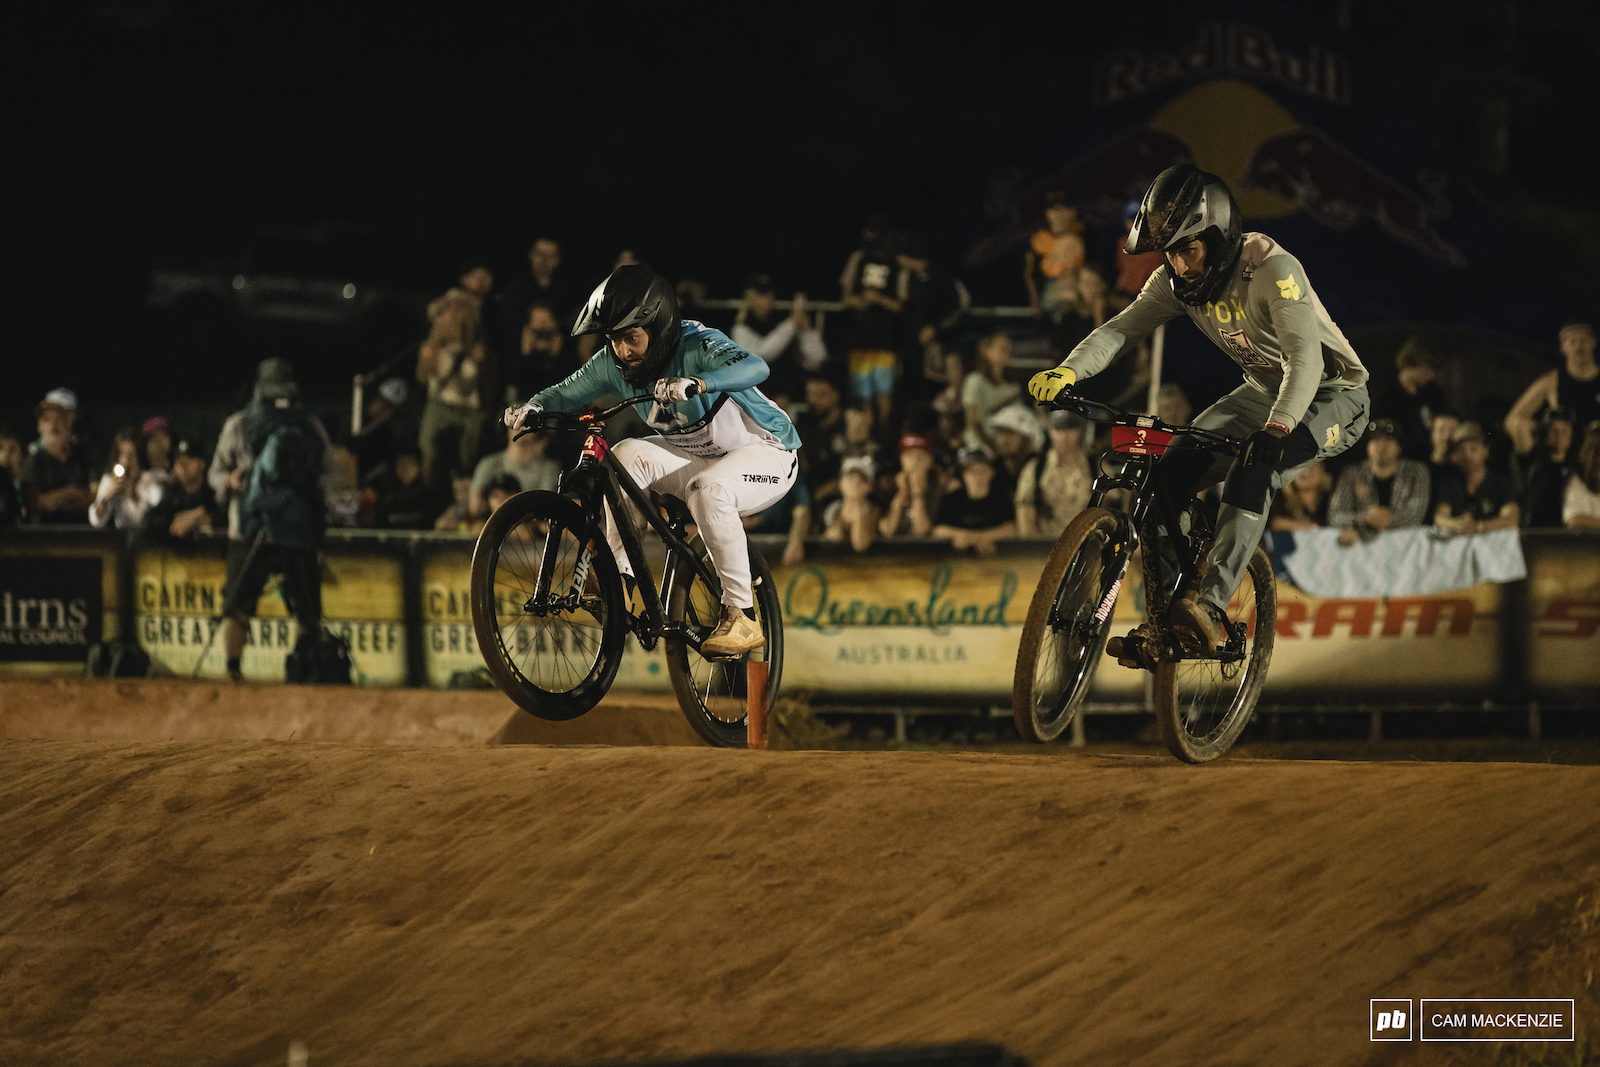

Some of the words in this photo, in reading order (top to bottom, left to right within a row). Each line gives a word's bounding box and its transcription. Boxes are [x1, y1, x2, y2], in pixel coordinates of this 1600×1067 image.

[1093, 20, 1224, 106] Red
[1225, 21, 1352, 106] Bull
[584, 435, 595, 449] 4
[1134, 430, 1147, 447] 3
[4, 591, 89, 630] irns
[429, 587, 522, 617] CAINS
[785, 563, 1020, 636] Queensland
[20, 630, 87, 645] COUNCIL
[837, 645, 967, 665] AUSTRALIA
